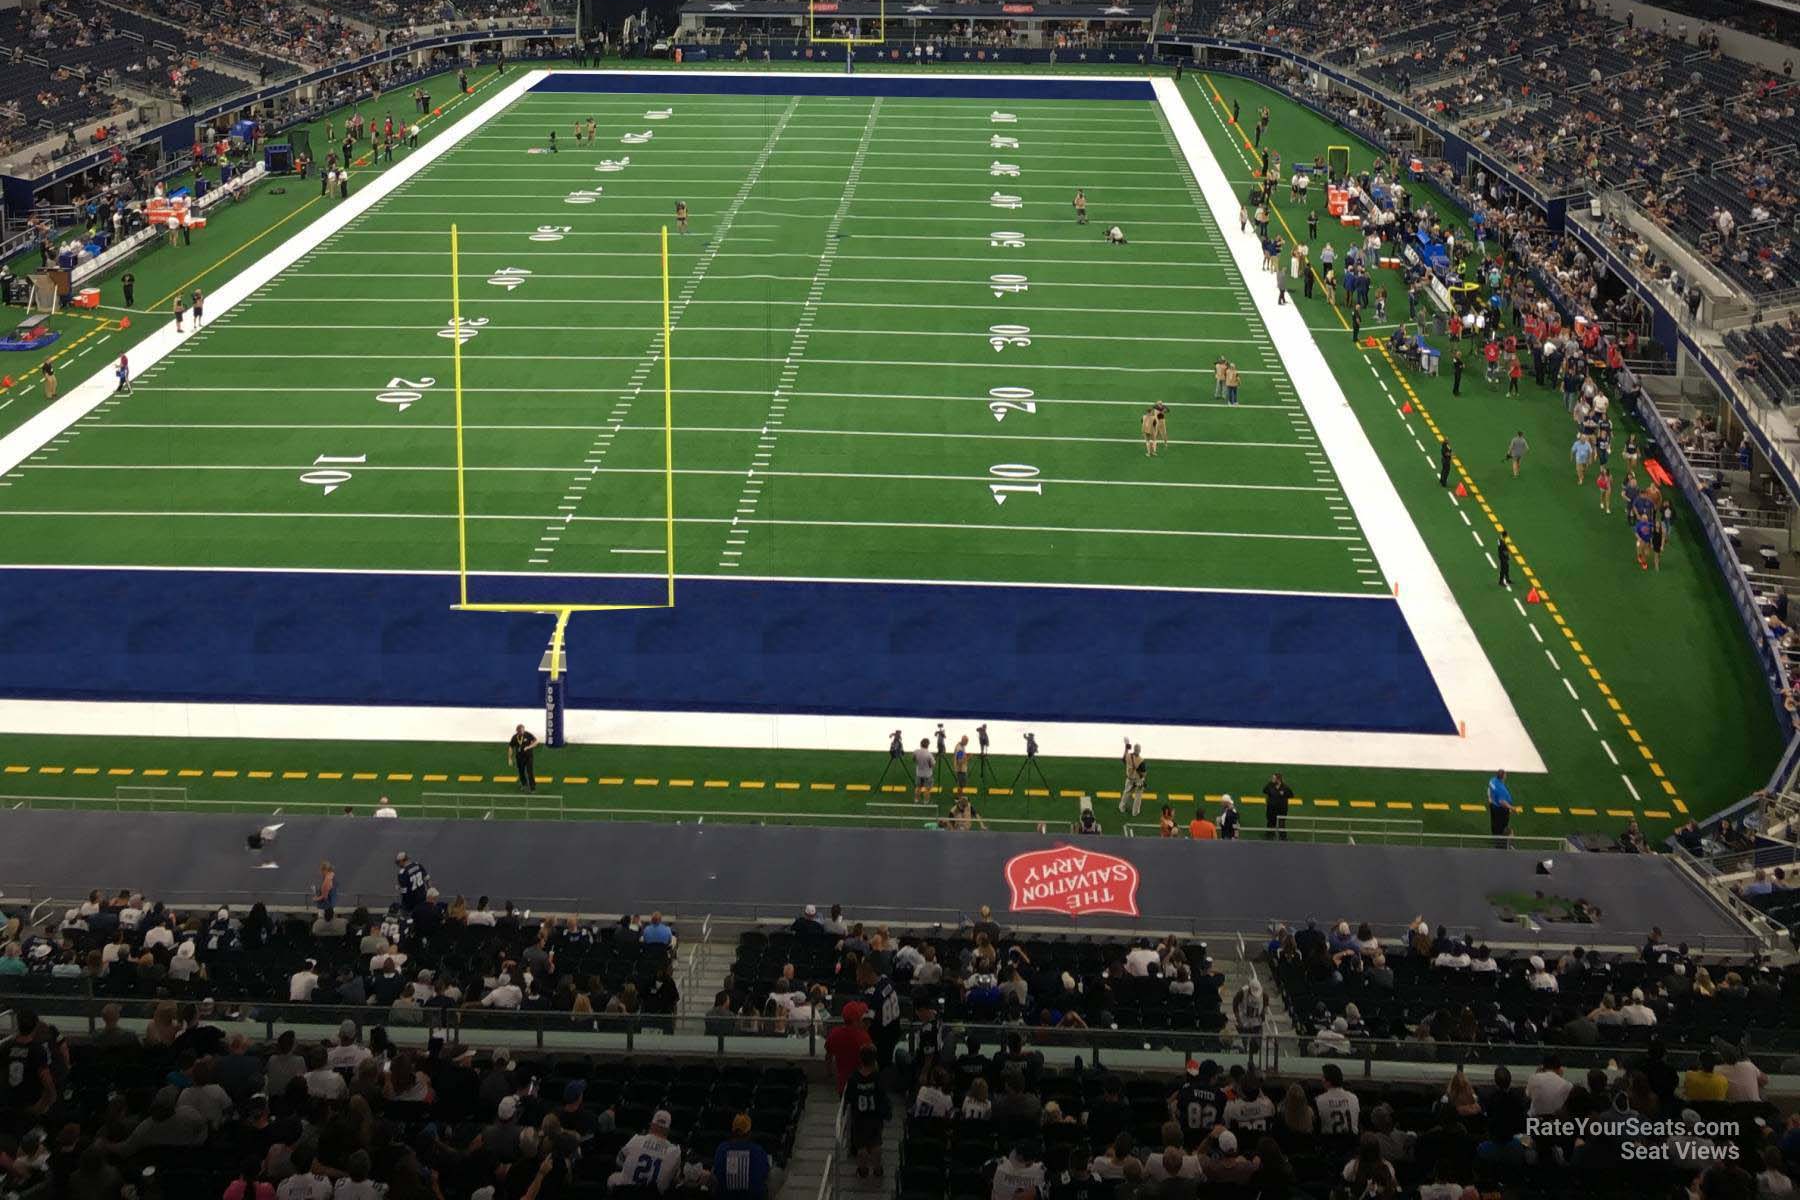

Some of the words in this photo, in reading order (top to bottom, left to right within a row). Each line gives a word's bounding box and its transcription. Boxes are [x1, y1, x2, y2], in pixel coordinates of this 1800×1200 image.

[990, 275, 1028, 292] 40
[436, 317, 489, 338] 30
[989, 325, 1031, 347] 30
[376, 377, 435, 403] 20
[989, 387, 1036, 414] 20
[300, 454, 367, 485] 10
[989, 464, 1041, 496] 10
[1025, 854, 1088, 884] ARMY
[1022, 864, 1128, 904] SALVATION
[1066, 887, 1115, 909] THE
[633, 1153, 662, 1185] 21
